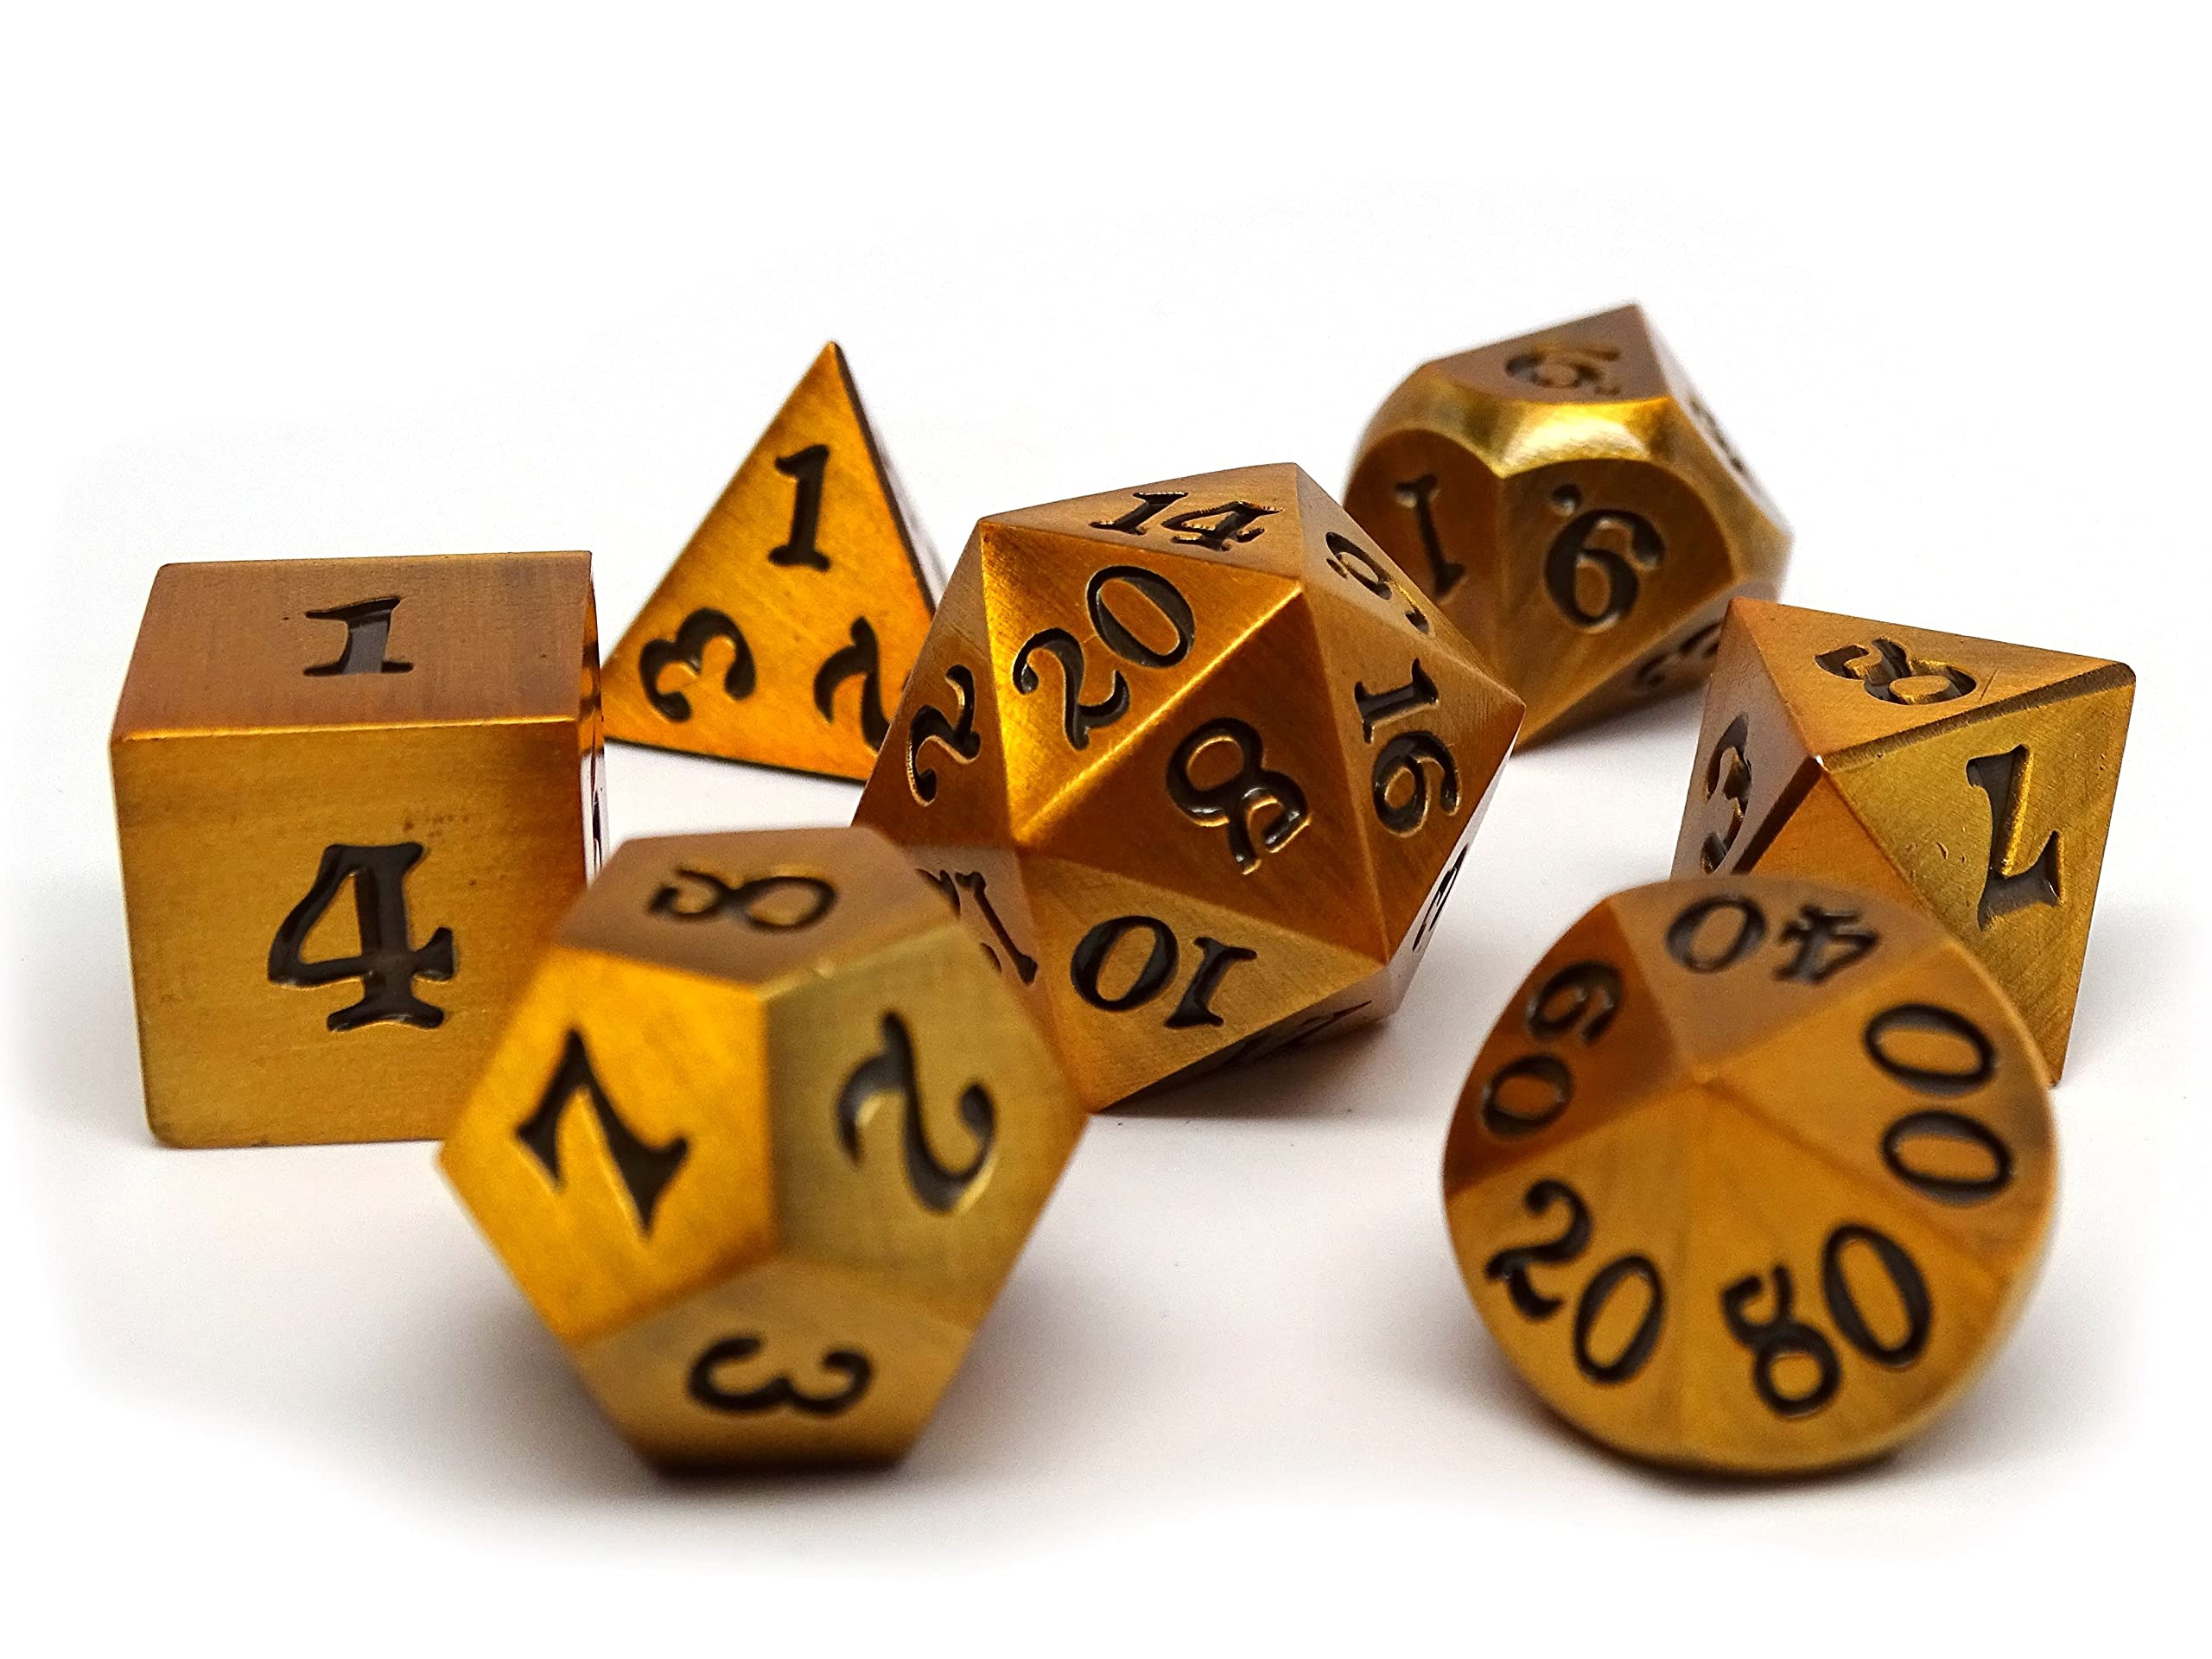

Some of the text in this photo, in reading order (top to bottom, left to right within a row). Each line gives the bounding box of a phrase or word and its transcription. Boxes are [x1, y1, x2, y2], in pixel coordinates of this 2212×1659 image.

[768, 444, 830, 572] 1
[1090, 492, 1282, 551] 14
[1395, 474, 1466, 605] 1
[304, 595, 414, 677] 1
[639, 608, 756, 722] 3
[1013, 565, 1196, 750] 20
[907, 664, 981, 806] 2
[1166, 717, 1312, 874] 8
[1354, 658, 1460, 837] 16
[268, 842, 454, 1033] 4
[646, 867, 837, 933] 8
[1071, 916, 1257, 1028] 10
[1665, 894, 1880, 986] 40
[836, 1009, 997, 1217] 2
[1481, 961, 1624, 1141] 60
[1863, 1003, 2016, 1203] 00
[515, 1026, 690, 1238] 7
[1484, 1179, 1665, 1384] 20
[1720, 1223, 1933, 1419] 80
[688, 1335, 875, 1418] 3
